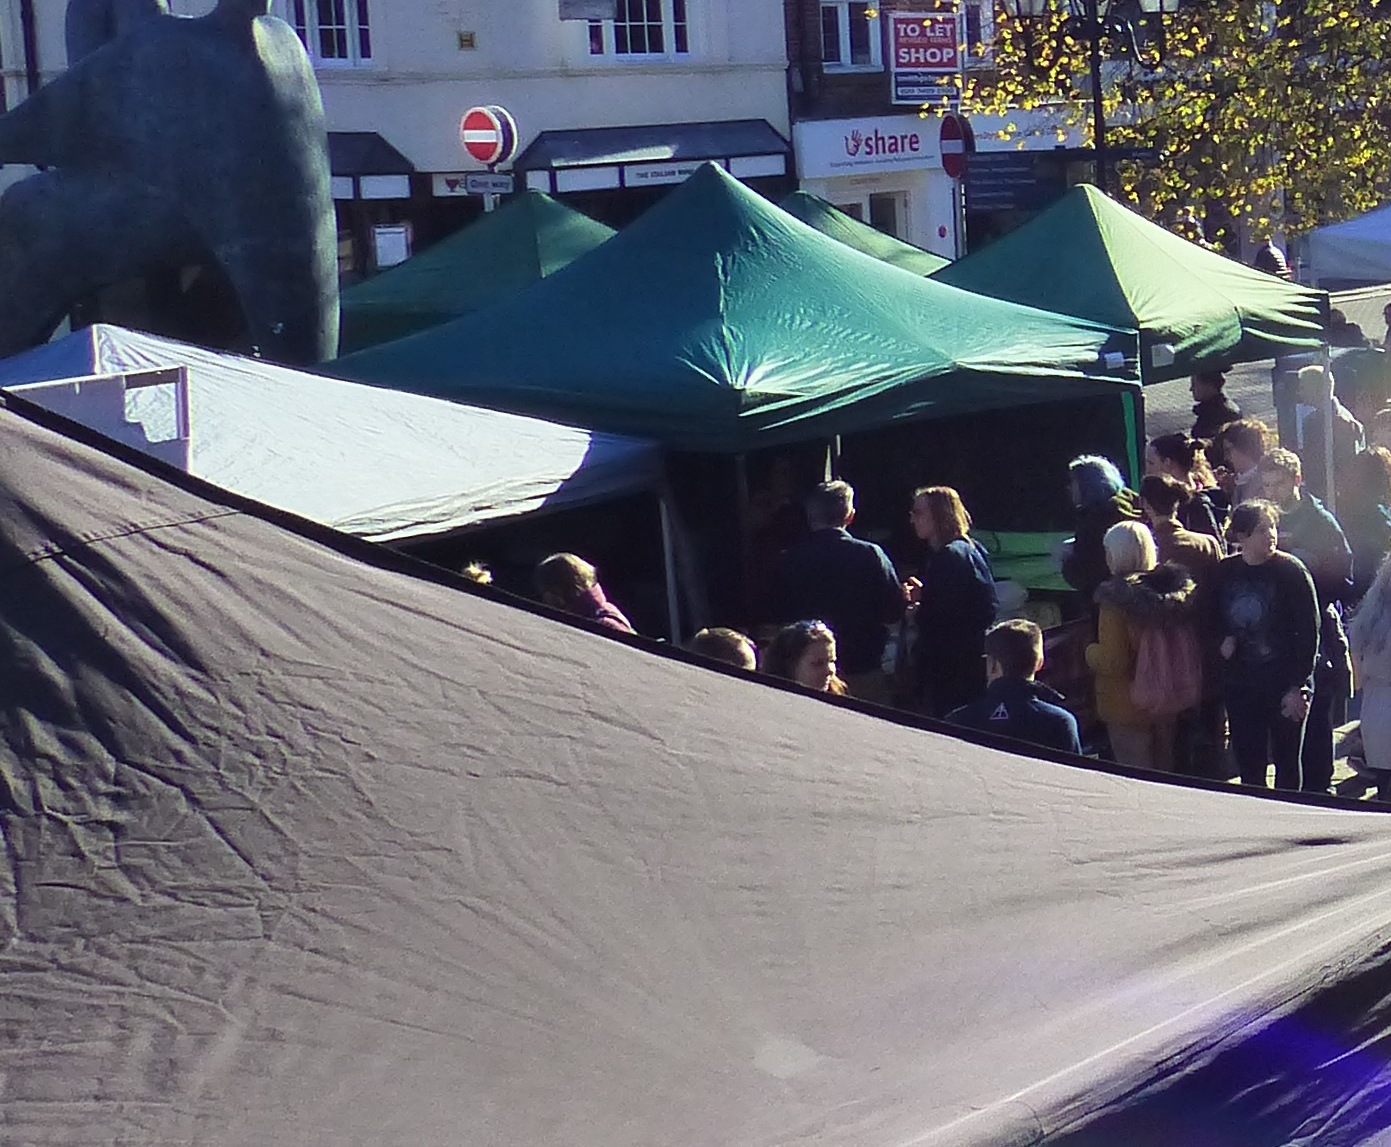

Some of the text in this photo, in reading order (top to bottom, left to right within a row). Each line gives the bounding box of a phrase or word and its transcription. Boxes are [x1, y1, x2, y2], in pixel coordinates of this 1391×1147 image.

[897, 23, 953, 37] TO LET
[898, 48, 954, 63] SHOP
[864, 128, 920, 156] share
